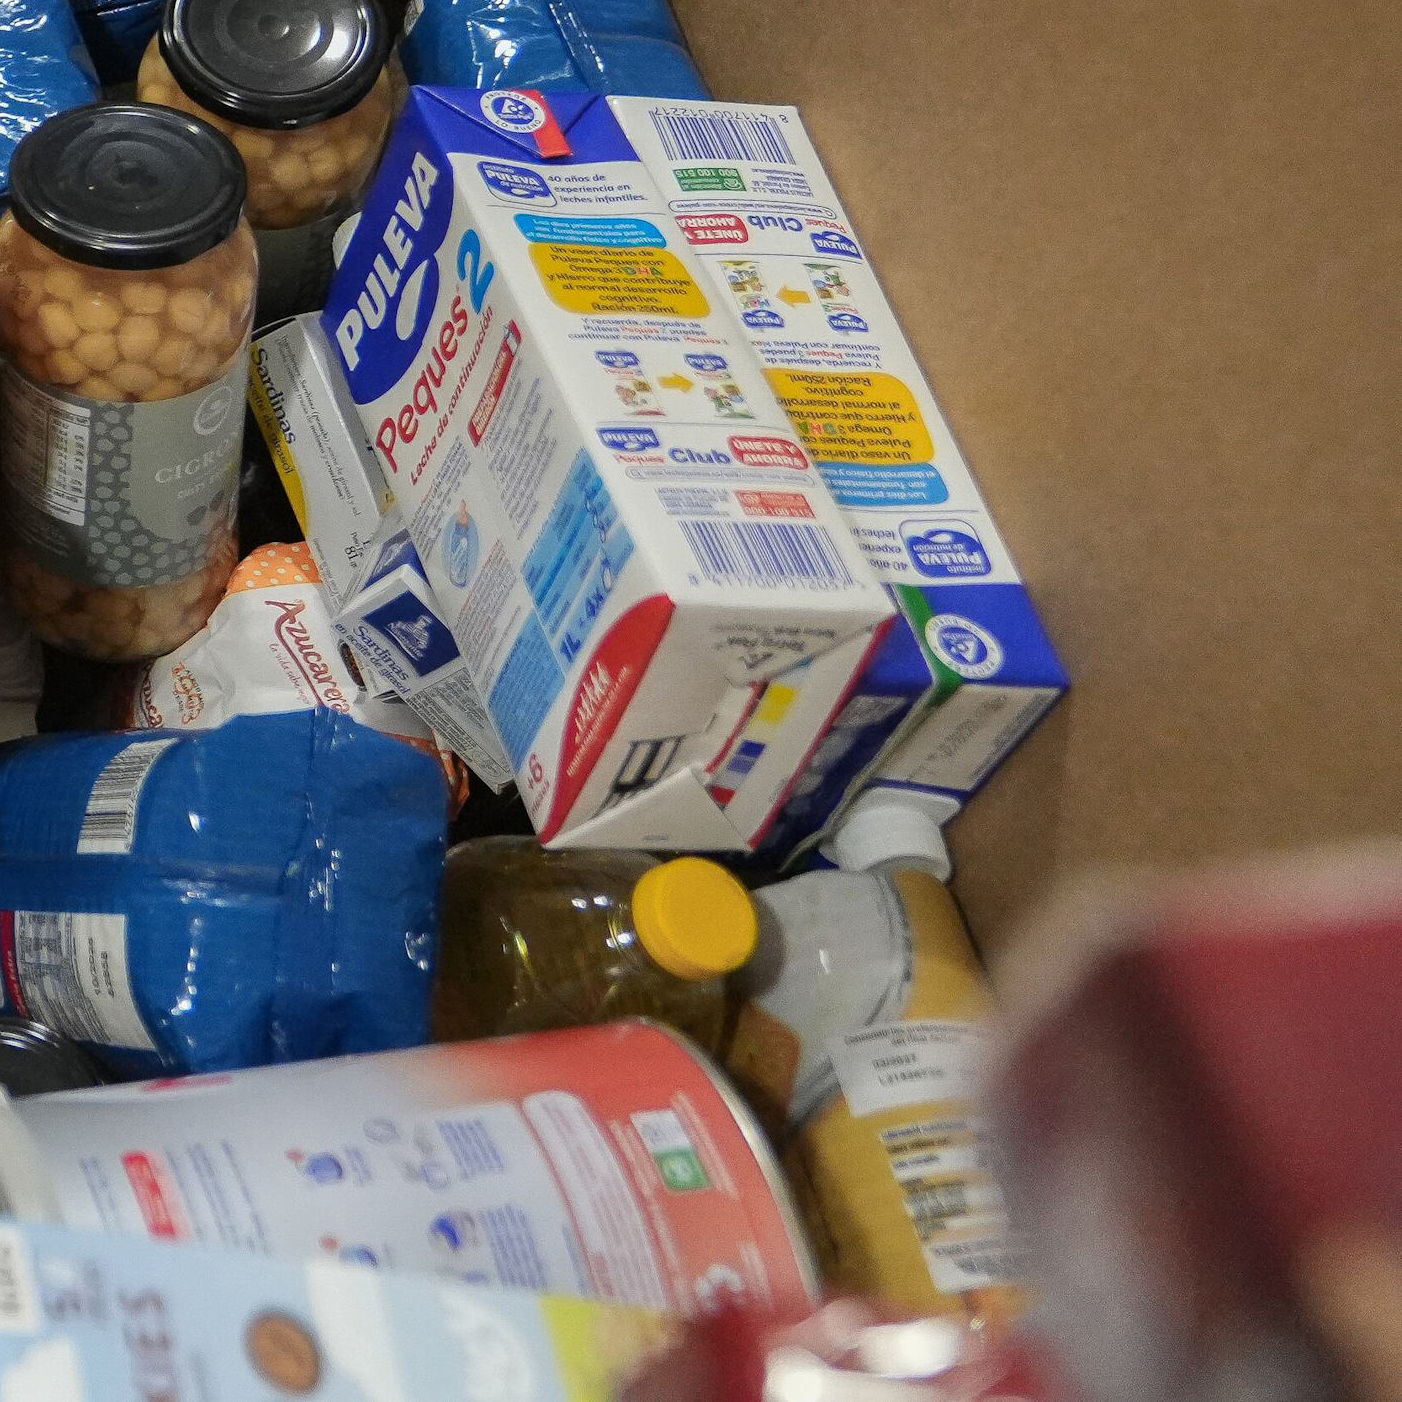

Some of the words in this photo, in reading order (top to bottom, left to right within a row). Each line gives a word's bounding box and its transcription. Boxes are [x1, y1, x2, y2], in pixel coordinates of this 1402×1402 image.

[487, 169, 538, 188] PULEVA
[548, 174, 561, 184] 40
[564, 173, 591, 184] años
[593, 173, 606, 183] de
[675, 167, 695, 178] 515
[696, 167, 717, 178] 100
[554, 183, 614, 195] experiencia
[617, 184, 630, 193] en
[560, 193, 592, 204] leches
[594, 193, 649, 204] infantiles.
[675, 217, 737, 228] AHORRA
[746, 215, 804, 233] Club
[805, 218, 848, 235] Peques
[698, 229, 743, 241] ÚNETE
[813, 238, 857, 253] PULEVA
[336, 151, 440, 372] PULEVA
[551, 254, 595, 265] Puleva
[456, 227, 496, 315] 2
[622, 277, 693, 289] contribuye
[576, 284, 622, 294] normal
[623, 286, 688, 297] desarrollo
[376, 293, 468, 474] Peques
[829, 376, 872, 387] Ración
[254, 348, 297, 446] Sardinas
[410, 436, 436, 487] Leche
[436, 416, 450, 438] de
[447, 305, 496, 418] continuación
[841, 400, 887, 410] normal
[839, 411, 862, 421] que
[866, 413, 908, 424] Hierro
[848, 424, 892, 436] Omega
[819, 436, 865, 447] Peques
[867, 438, 912, 449] Puleva
[668, 447, 732, 465] Club
[822, 450, 859, 460] diario
[861, 451, 890, 460] vaso
[893, 451, 913, 461] Un
[917, 551, 982, 566] PULEVA
[264, 598, 351, 714] Azucarera
[334, 622, 348, 636] en
[346, 634, 373, 660] aceite
[366, 656, 382, 669] de
[376, 667, 410, 695] girasol
[353, 625, 409, 682] Sardinas
